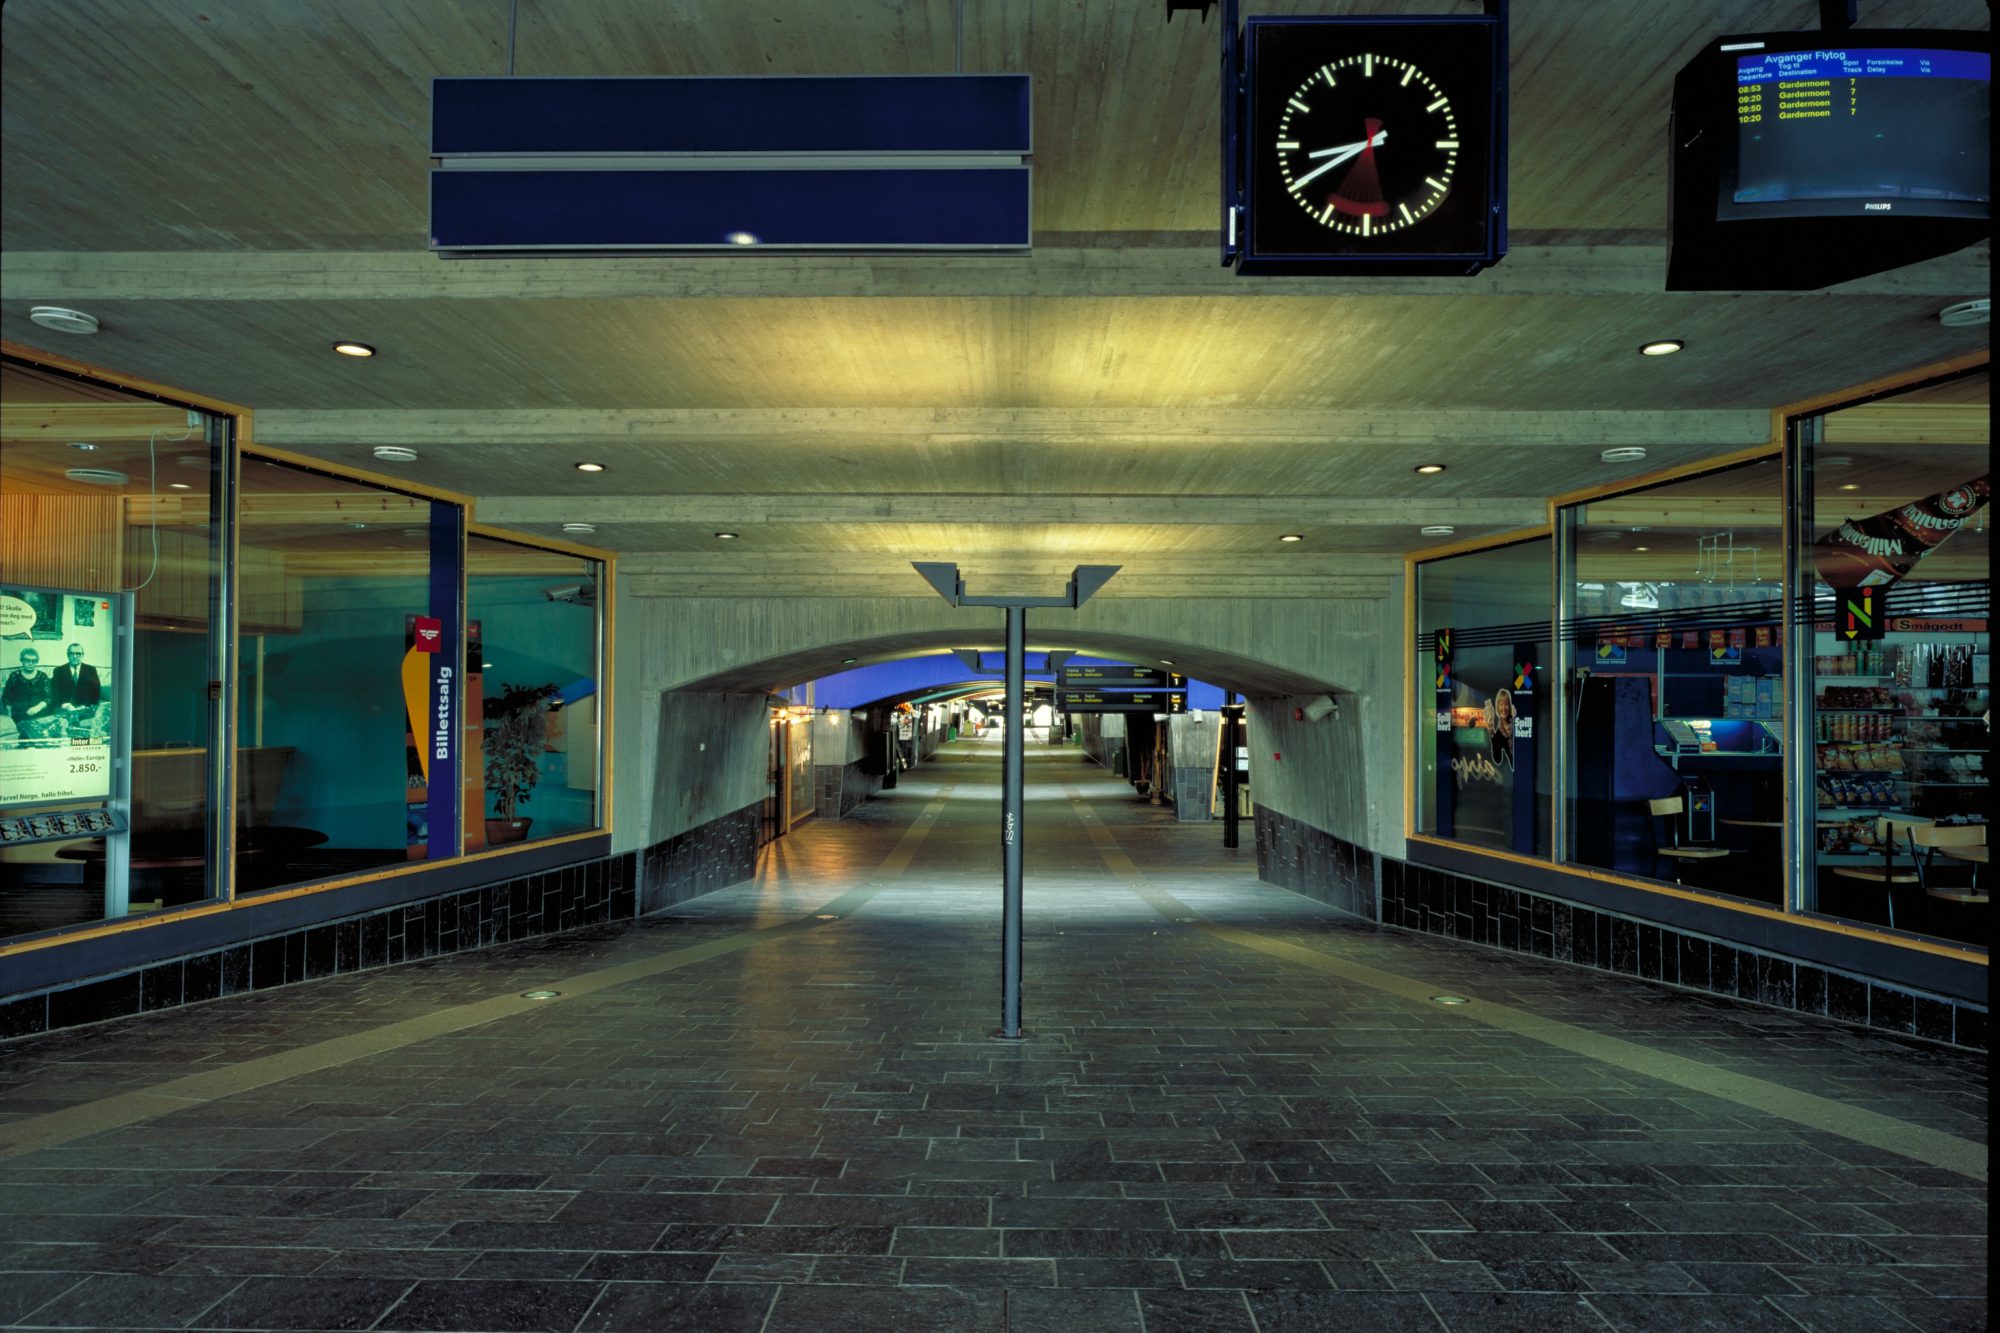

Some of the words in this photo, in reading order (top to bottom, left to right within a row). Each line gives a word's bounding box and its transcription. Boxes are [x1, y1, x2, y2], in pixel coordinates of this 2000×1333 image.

[1765, 53, 1813, 64] Avganger
[1815, 51, 1846, 62] Flytog
[1738, 66, 1764, 75] Avgang
[1738, 72, 1773, 82] Departure
[1779, 69, 1817, 77] Destination
[1738, 85, 1762, 94] 08:53
[1779, 79, 1830, 90] Gardermoen
[1850, 78, 1856, 86] 7
[1738, 95, 1762, 104] 09:20
[1779, 89, 1830, 99] Gardermoen
[1738, 104, 1762, 114] 09:50
[1779, 99, 1830, 109] Gardermoen
[1738, 114, 1762, 124] 10:20
[1779, 109, 1830, 119] Gardermoen
[1850, 108, 1856, 116] 7
[1900, 620, 1964, 631] Smågodt
[1174, 677, 1179, 686] 1
[436, 666, 452, 759] Billettsalg
[1173, 703, 1179, 711] 2
[1514, 717, 1532, 728] Spill
[1515, 726, 1532, 738] her!
[70, 763, 102, 773] 2.850,-
